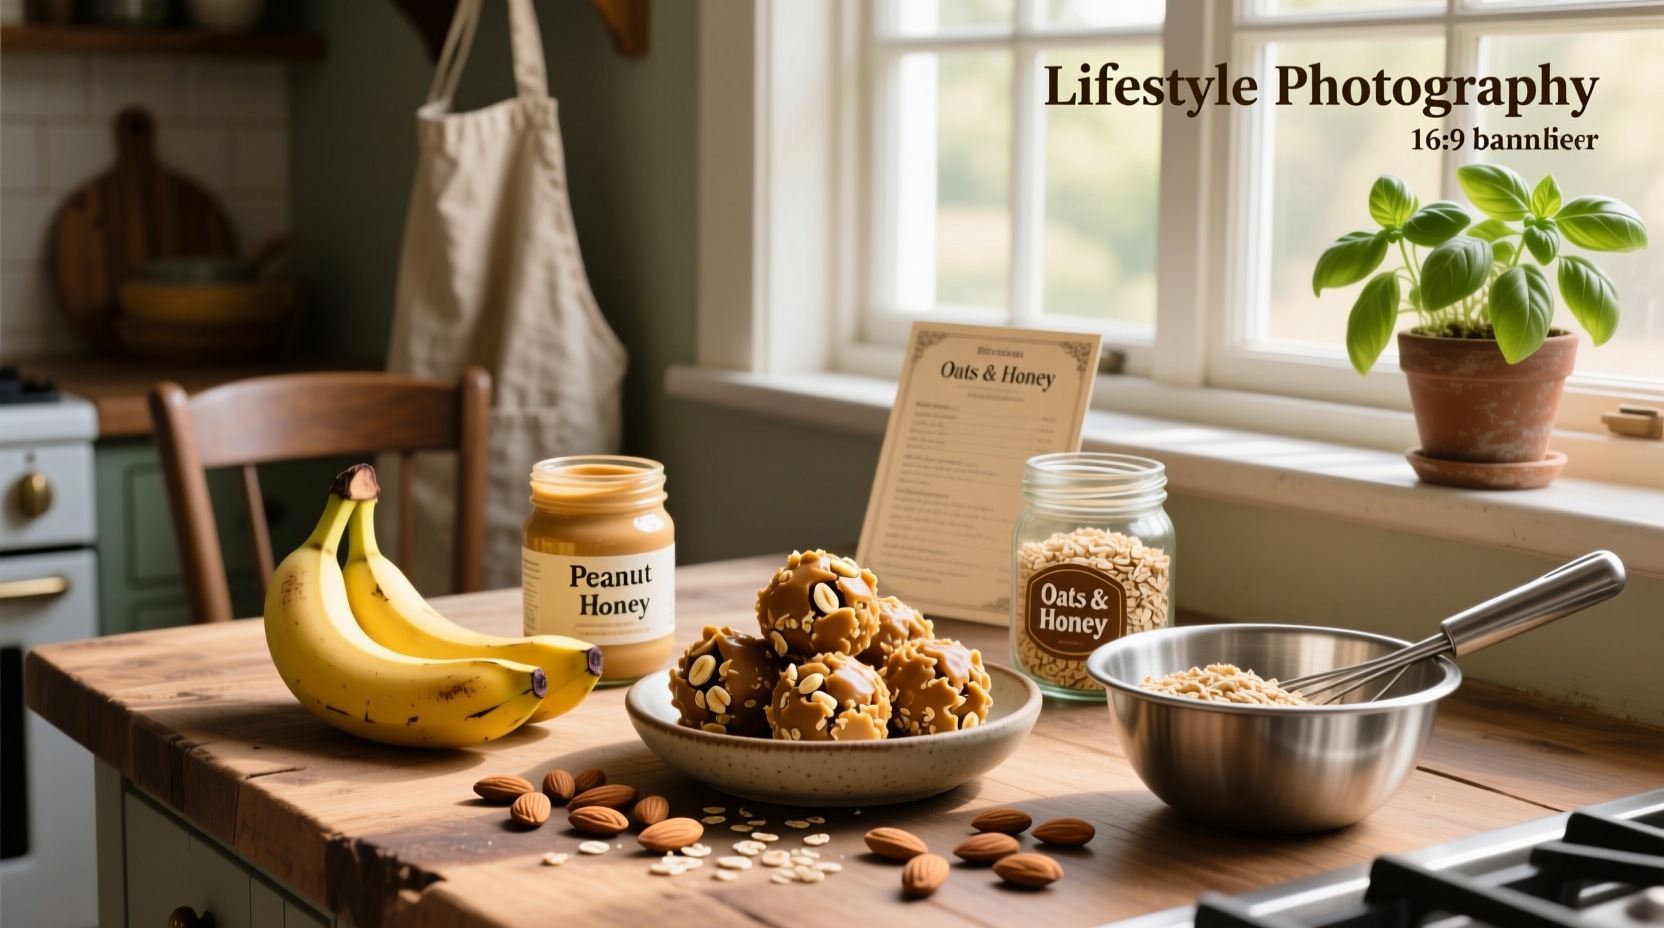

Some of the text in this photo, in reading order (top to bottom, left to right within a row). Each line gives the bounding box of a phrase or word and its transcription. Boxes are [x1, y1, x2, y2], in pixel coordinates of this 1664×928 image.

[940, 360, 1056, 393] Oats & Honey
[569, 564, 652, 588] Peanut
[579, 594, 651, 620] Honey
[1041, 582, 1109, 610] Oats &
[1039, 607, 1109, 640] Honey
